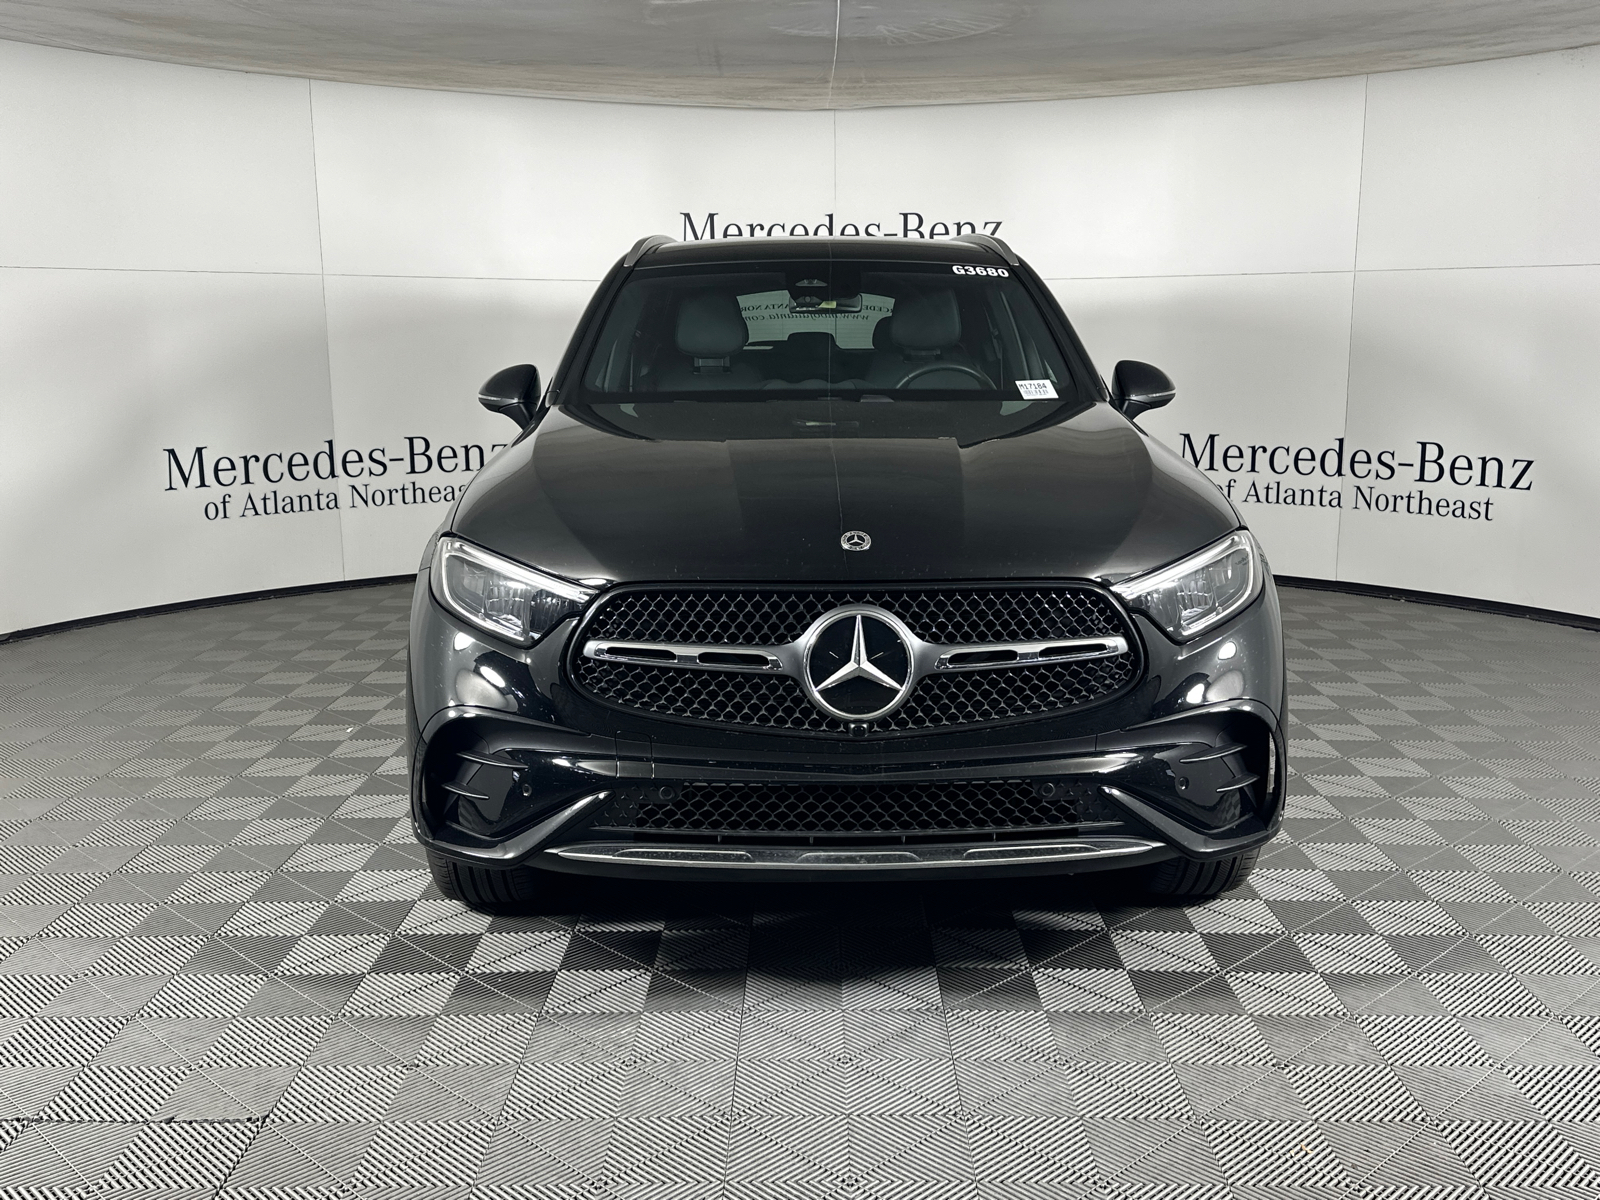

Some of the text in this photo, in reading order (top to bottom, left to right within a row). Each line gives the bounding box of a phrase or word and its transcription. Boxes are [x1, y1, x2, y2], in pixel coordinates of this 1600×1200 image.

[952, 265, 1009, 277] G3680
[1018, 382, 1047, 390] M17184
[1178, 432, 1535, 492] Mercedes-Benz
[204, 481, 466, 521] of Atlanta Northea
[1241, 479, 1342, 509] Atlanta
[1353, 485, 1494, 522] Northeast
